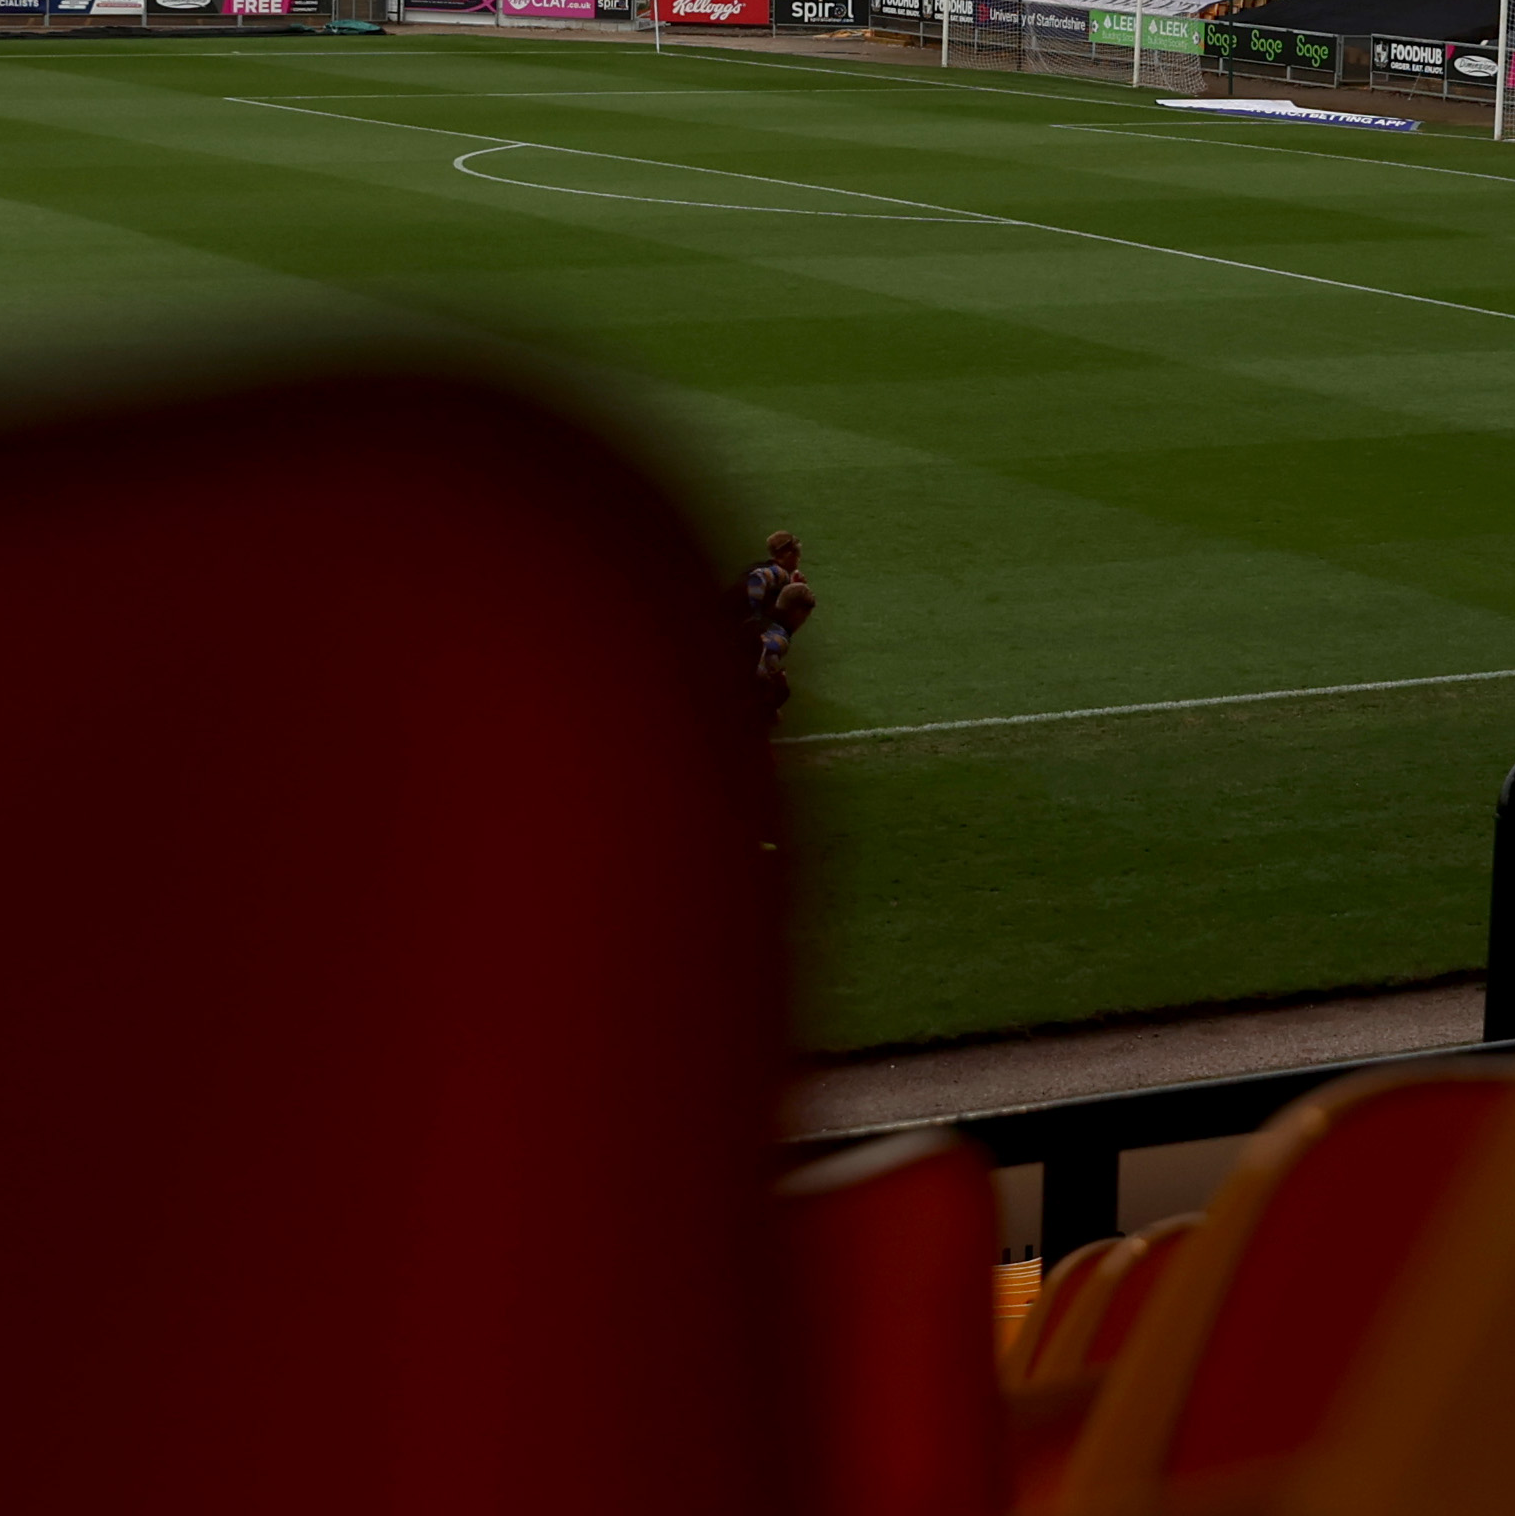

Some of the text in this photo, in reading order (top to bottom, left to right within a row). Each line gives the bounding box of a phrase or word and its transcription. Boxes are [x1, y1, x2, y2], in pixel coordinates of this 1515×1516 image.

[1027, 15, 1034, 24] of
[1113, 15, 1135, 31] LEE
[1159, 20, 1188, 37] LEEK
[1250, 30, 1283, 62] Sage
[1296, 34, 1329, 67] Sage
[1390, 43, 1443, 64] FOODHUB
[1390, 62, 1443, 75] ORDER. EAT. ENJOY.
[1376, 118, 1407, 127] APP
